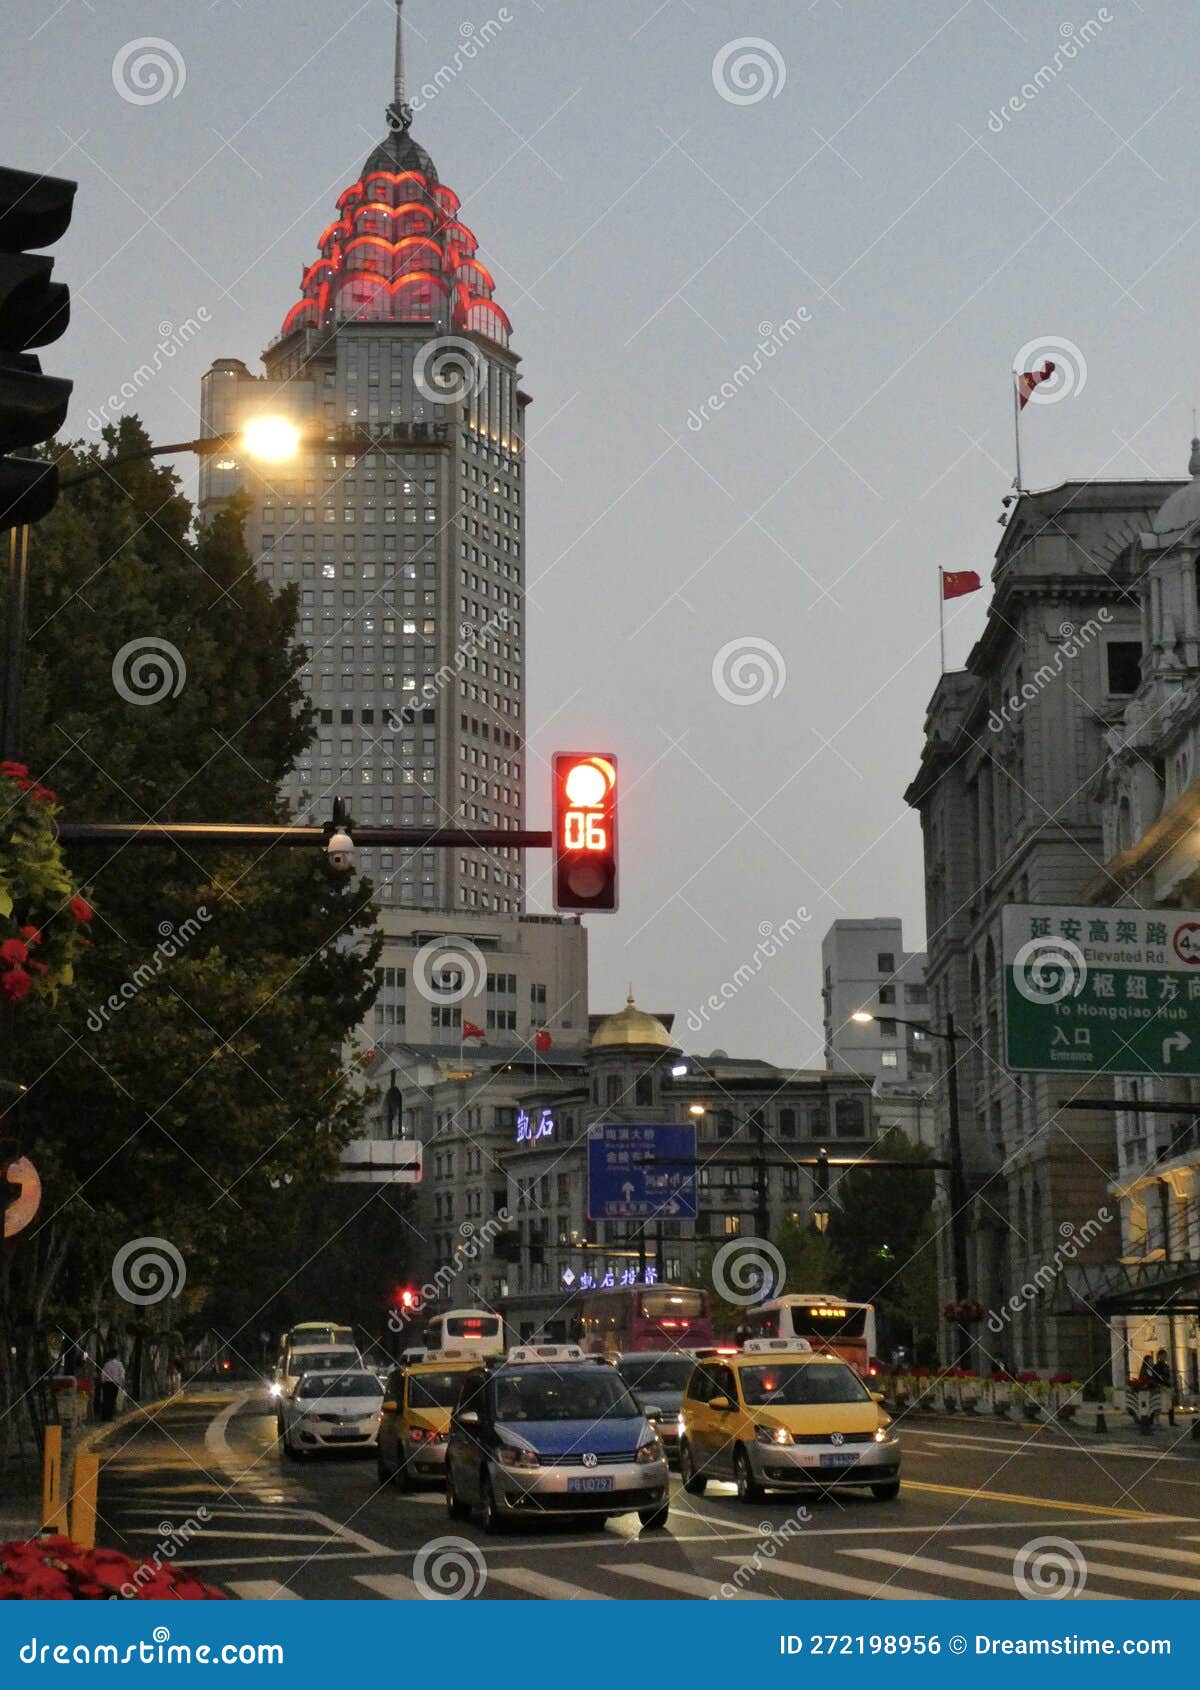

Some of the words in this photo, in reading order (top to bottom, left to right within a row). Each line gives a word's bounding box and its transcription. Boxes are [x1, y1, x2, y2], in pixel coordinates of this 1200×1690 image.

[565, 812, 606, 850] 06
[1030, 917, 1168, 946] 延安高架路
[1083, 948, 1142, 963] Elevated
[1146, 951, 1168, 964] Rd.
[1054, 1003, 1071, 1016] To
[1077, 1004, 1151, 1020] Hongqiao
[1157, 1006, 1188, 1019] Hub
[1052, 1026, 1090, 1045] 入口
